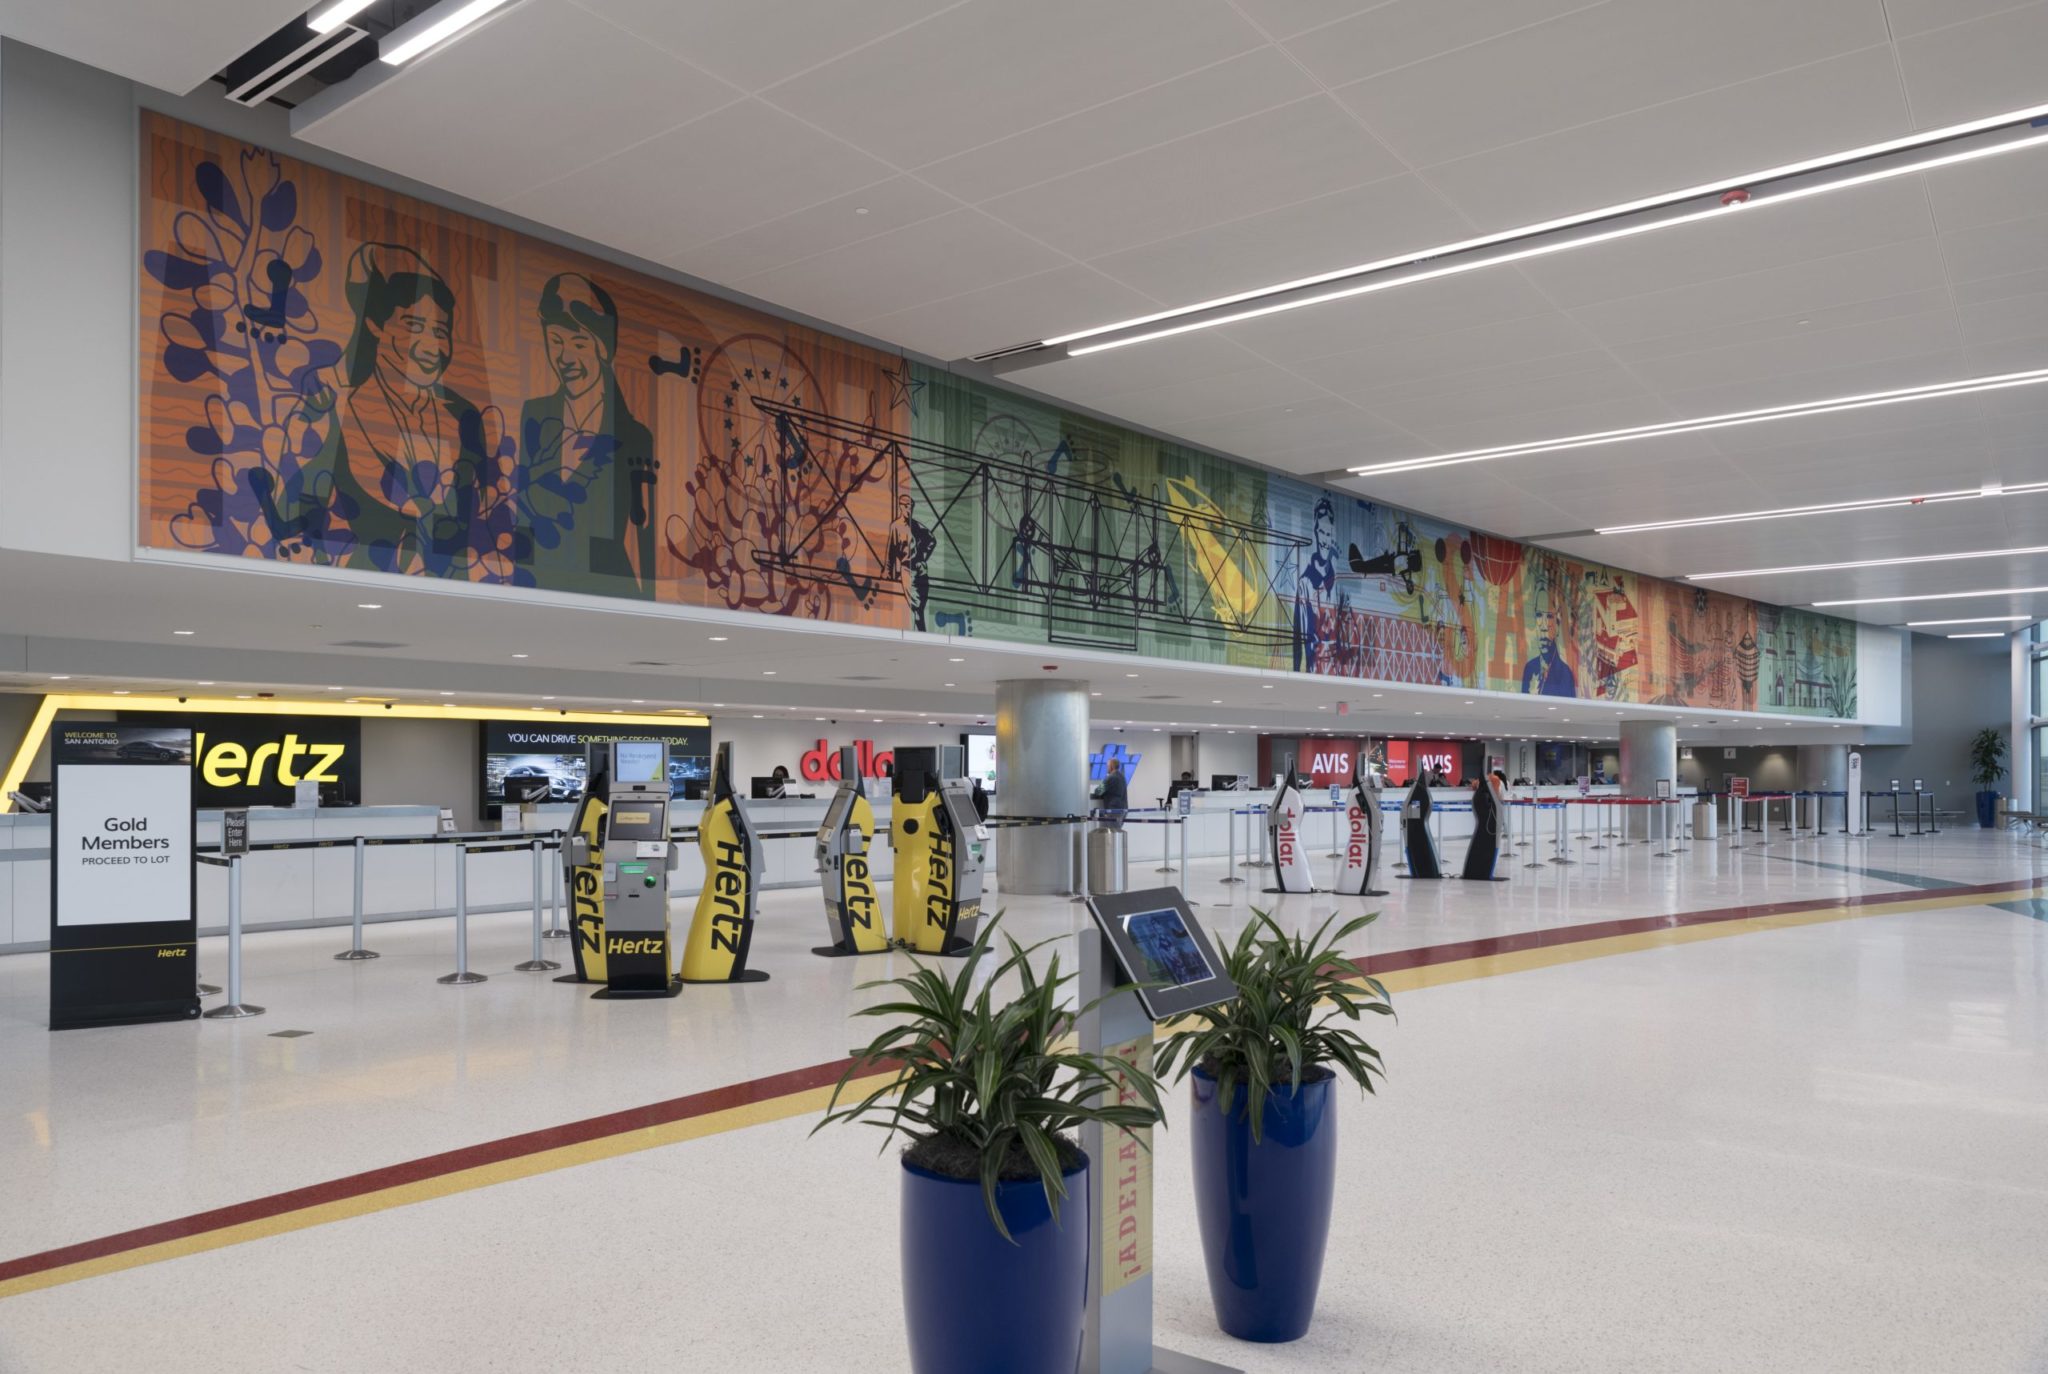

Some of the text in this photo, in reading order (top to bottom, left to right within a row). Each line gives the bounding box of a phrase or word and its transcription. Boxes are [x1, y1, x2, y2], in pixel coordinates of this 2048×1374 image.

[64, 731, 104, 739] WELCOME
[507, 733, 529, 743] YOU
[529, 734, 551, 743] CAN
[551, 734, 577, 744] DRIVE
[196, 732, 345, 787] ertz
[1311, 753, 1349, 774] AVIS
[1422, 754, 1452, 774] AVIS
[104, 817, 147, 831] Gold
[226, 817, 246, 827] Please
[228, 827, 243, 837] Enter
[81, 835, 170, 850] Members
[228, 837, 243, 847] Here
[82, 855, 170, 865] PROCEED TO LOT
[927, 831, 952, 932] Hertz
[710, 839, 747, 955] Hertz
[958, 904, 981, 921] Hertz
[608, 937, 664, 954] Hertz
[157, 948, 188, 958] Hertz
